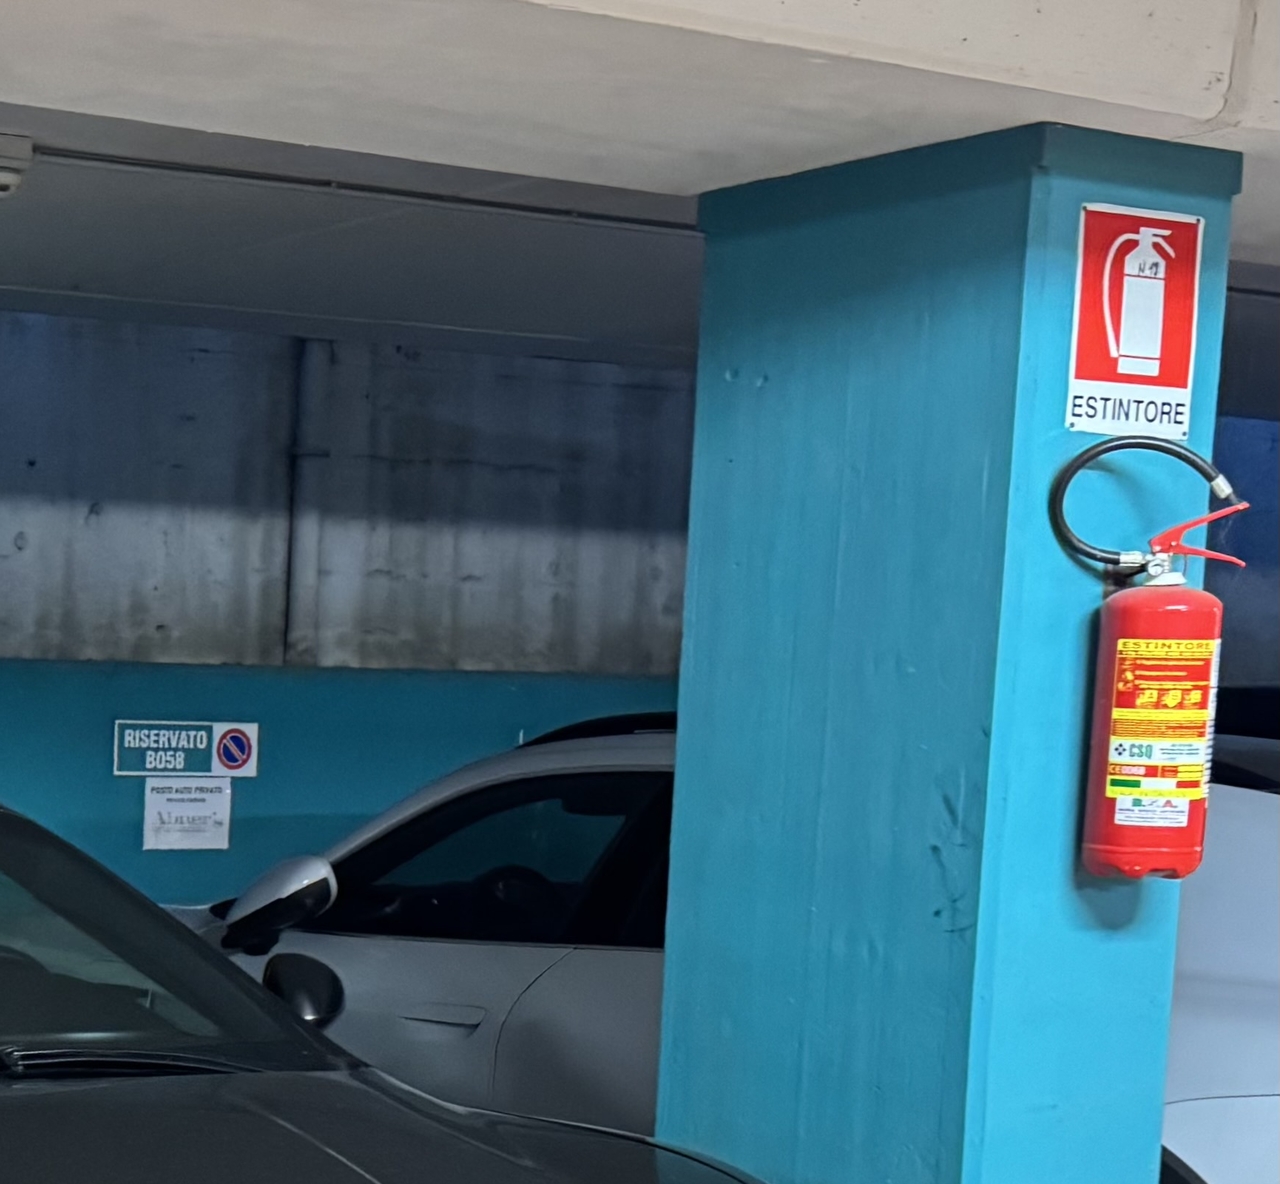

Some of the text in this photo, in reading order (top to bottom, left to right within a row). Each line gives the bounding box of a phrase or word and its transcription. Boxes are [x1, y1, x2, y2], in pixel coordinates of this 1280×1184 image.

[1071, 395, 1186, 425] ESTINTORE
[1121, 641, 1212, 650] ESTINTORE
[124, 729, 208, 749] RISERVATO
